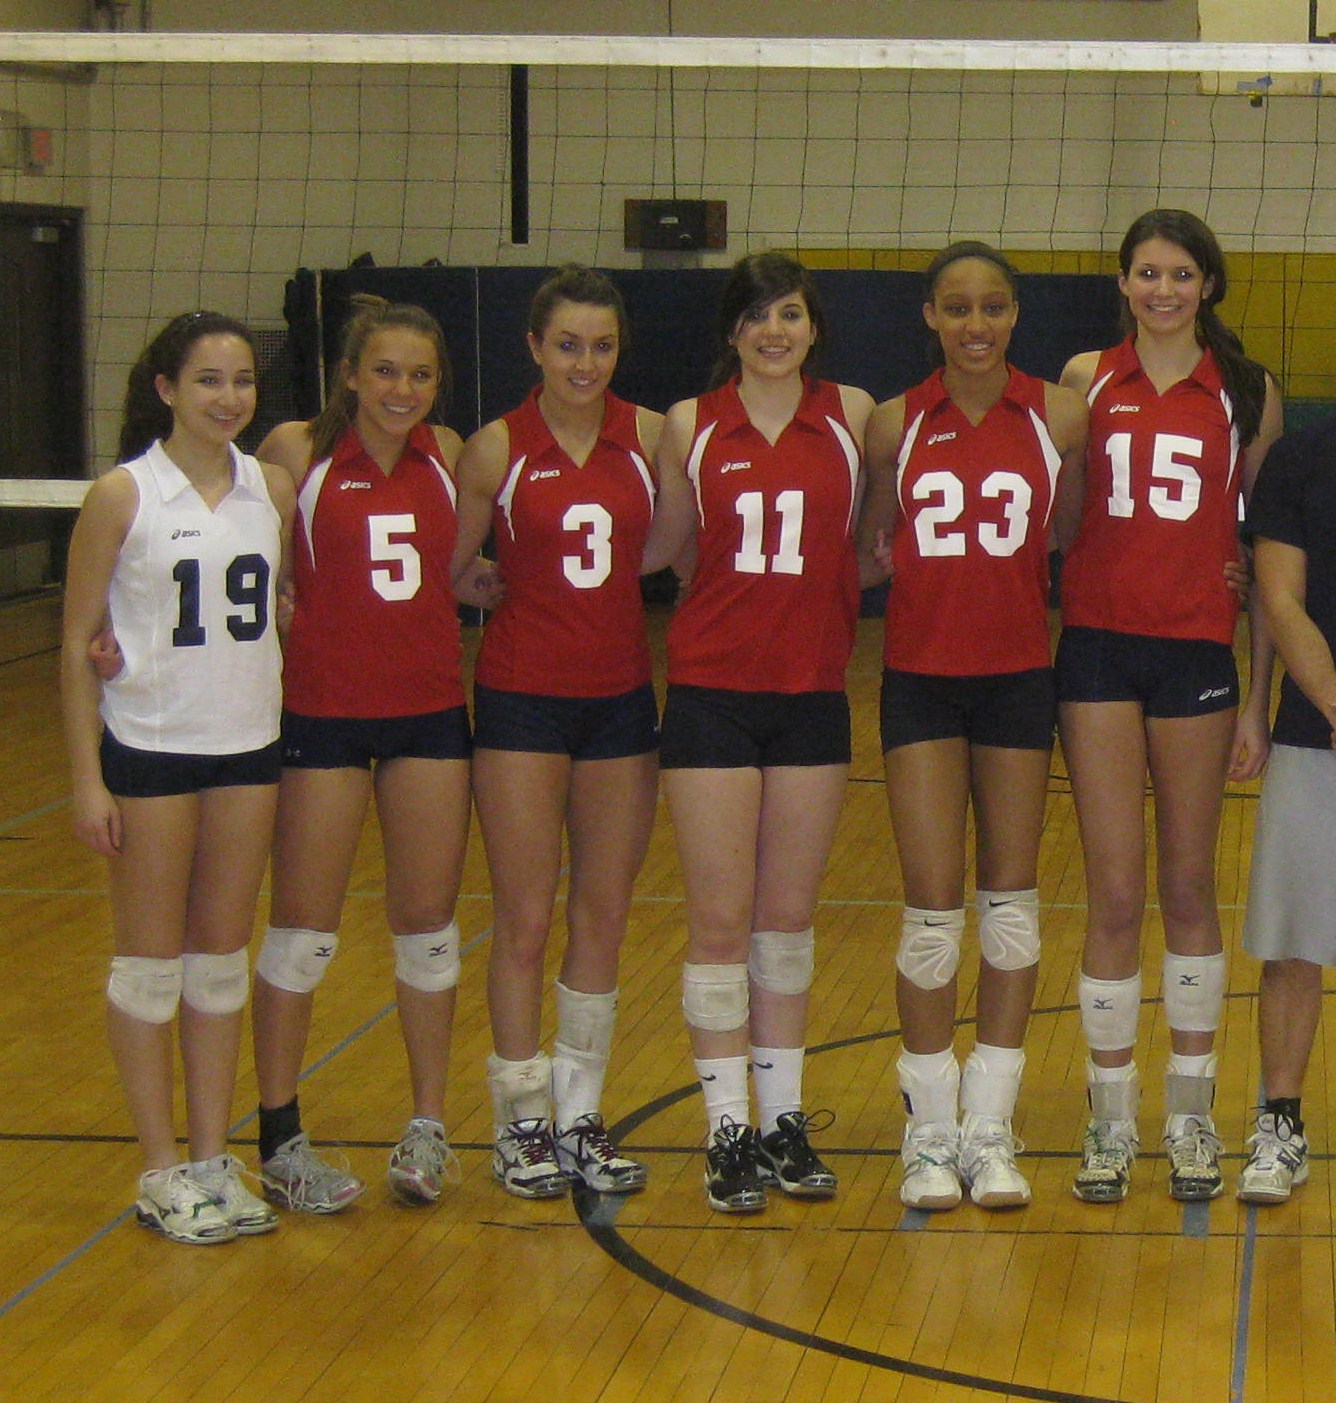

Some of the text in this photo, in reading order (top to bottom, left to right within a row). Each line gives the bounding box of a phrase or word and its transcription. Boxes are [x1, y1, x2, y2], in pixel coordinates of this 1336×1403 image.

[912, 471, 1032, 557] 23
[1105, 433, 1203, 521] 15
[368, 514, 421, 601] 5
[562, 504, 612, 588] 3
[735, 490, 804, 575] 11
[173, 554, 269, 647] 19
